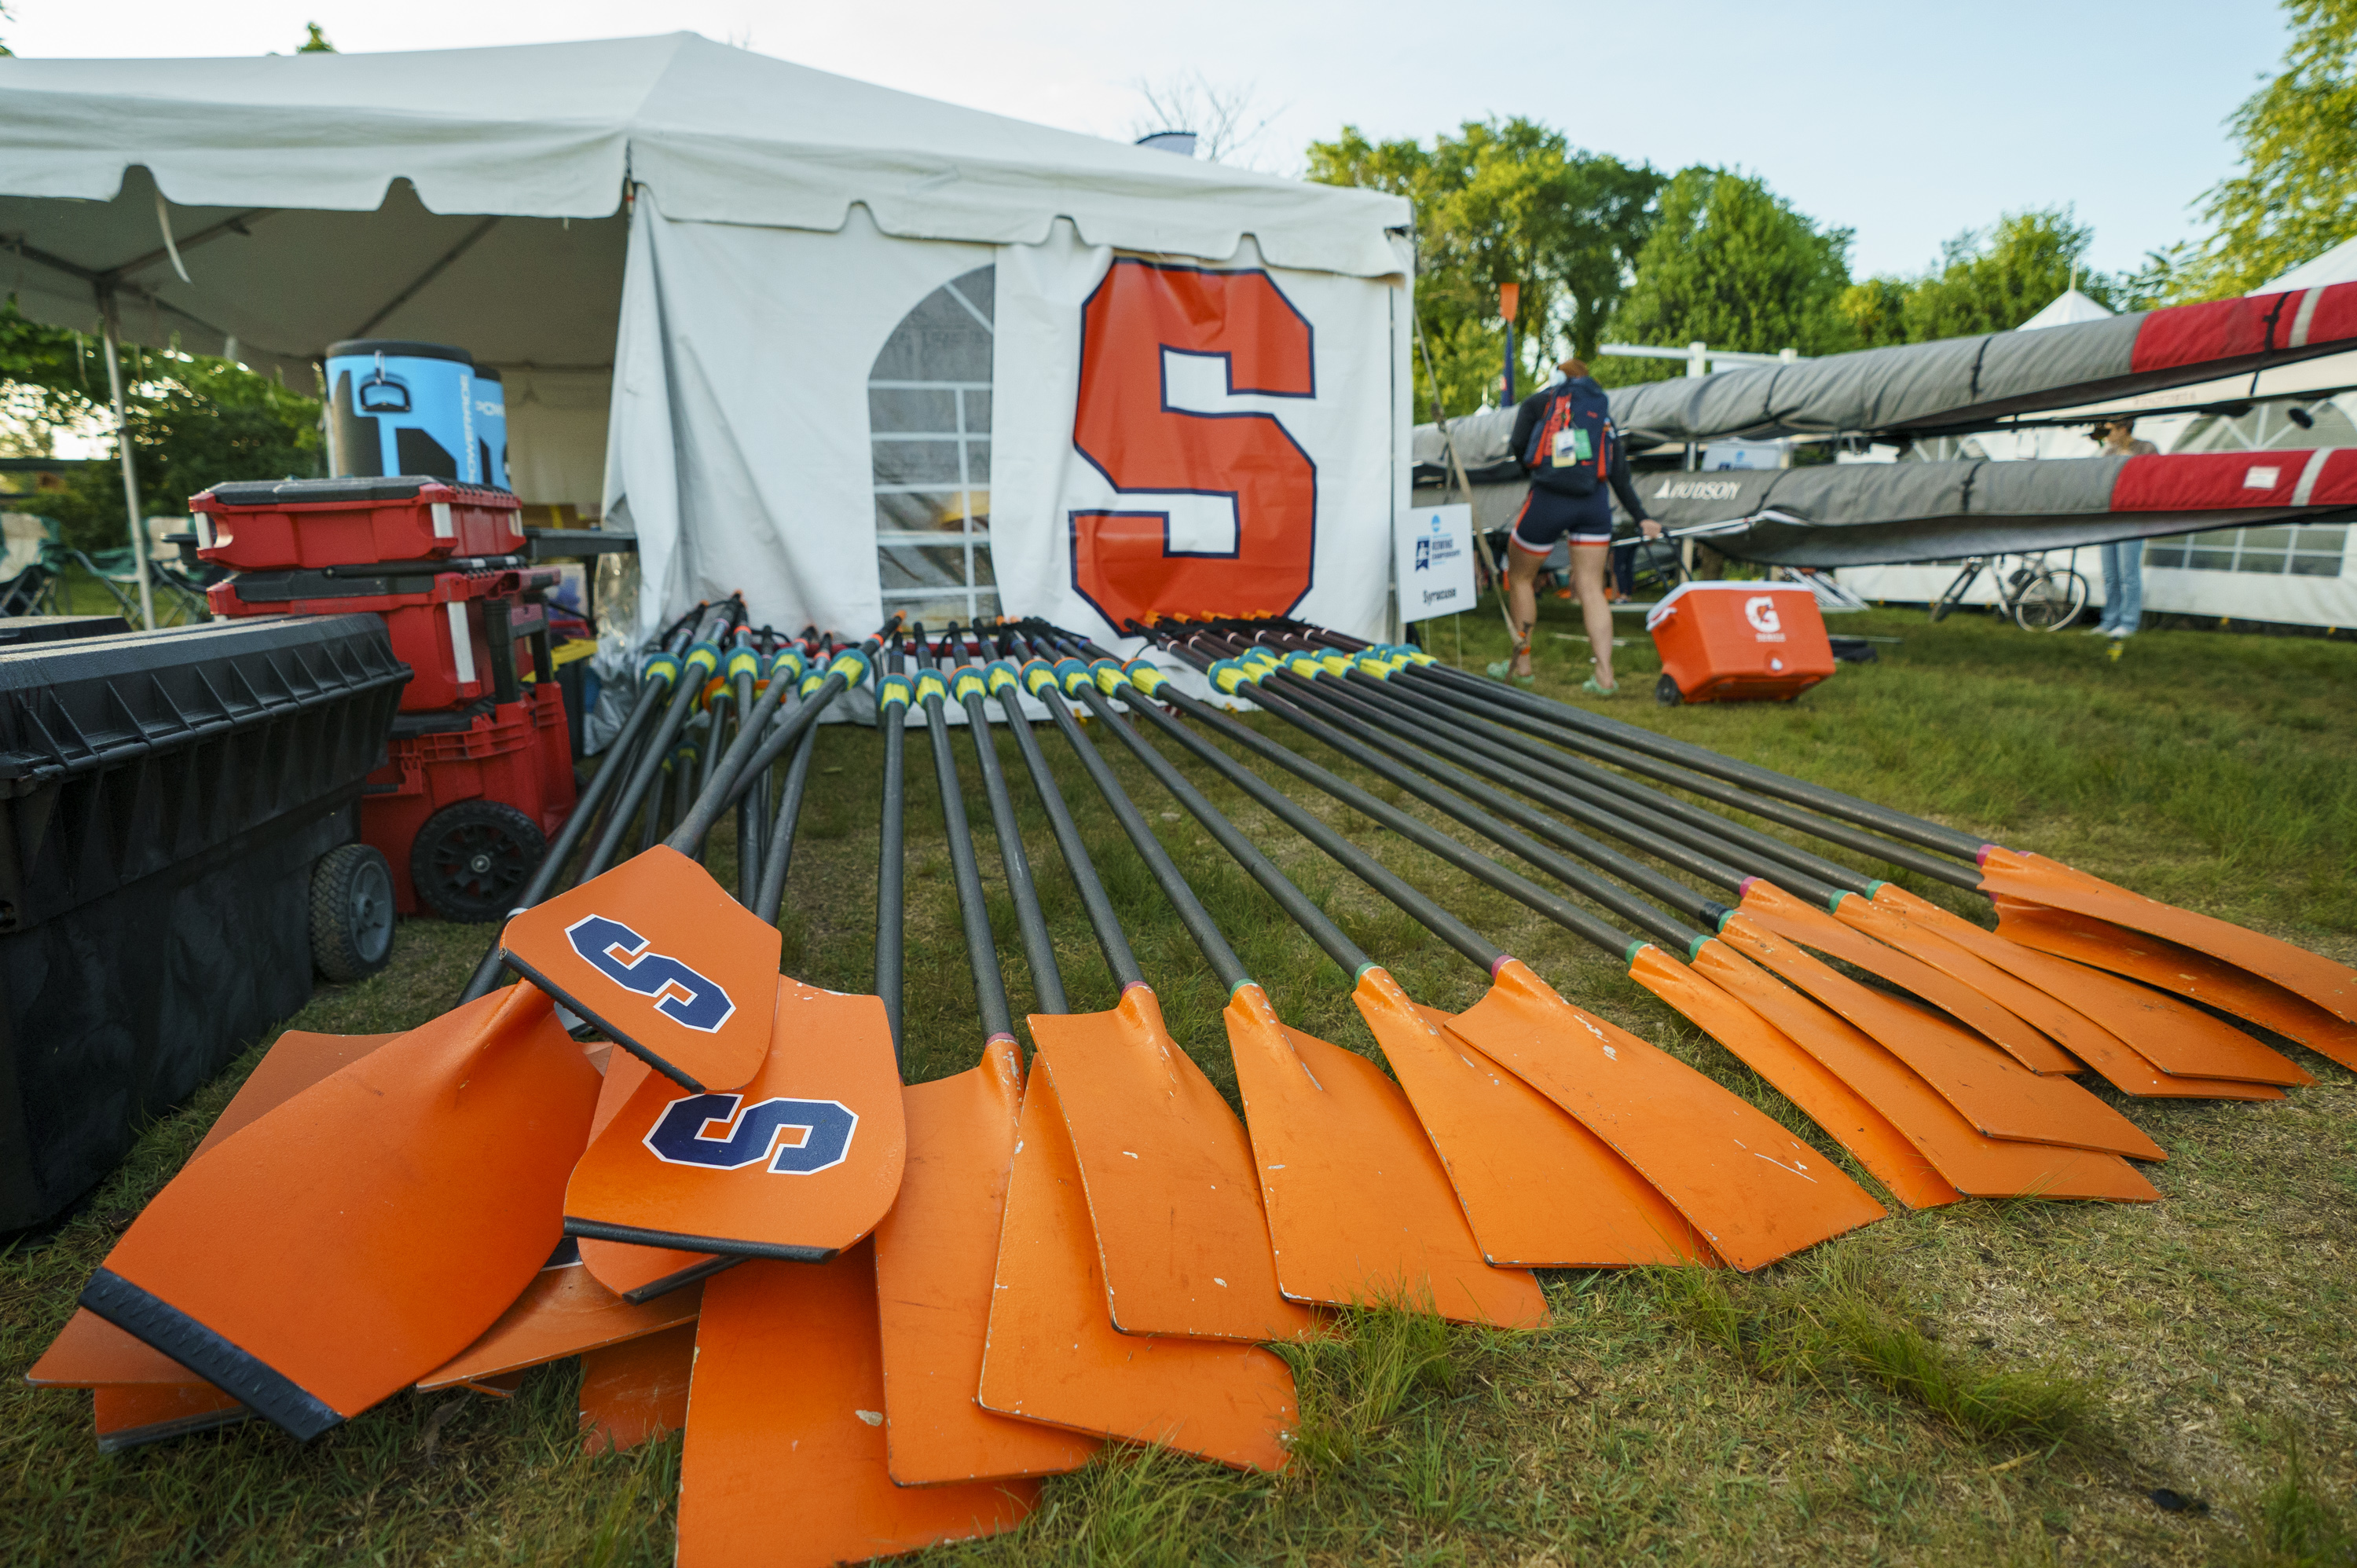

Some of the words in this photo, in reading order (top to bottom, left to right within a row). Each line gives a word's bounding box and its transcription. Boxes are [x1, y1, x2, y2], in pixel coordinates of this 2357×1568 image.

[1069, 255, 1318, 639] S
[1670, 481, 1742, 500] HUDSON
[1424, 588, 1456, 605] Syracuse
[1745, 595, 1781, 633] G
[564, 913, 736, 1034] S
[642, 1093, 860, 1174] S
